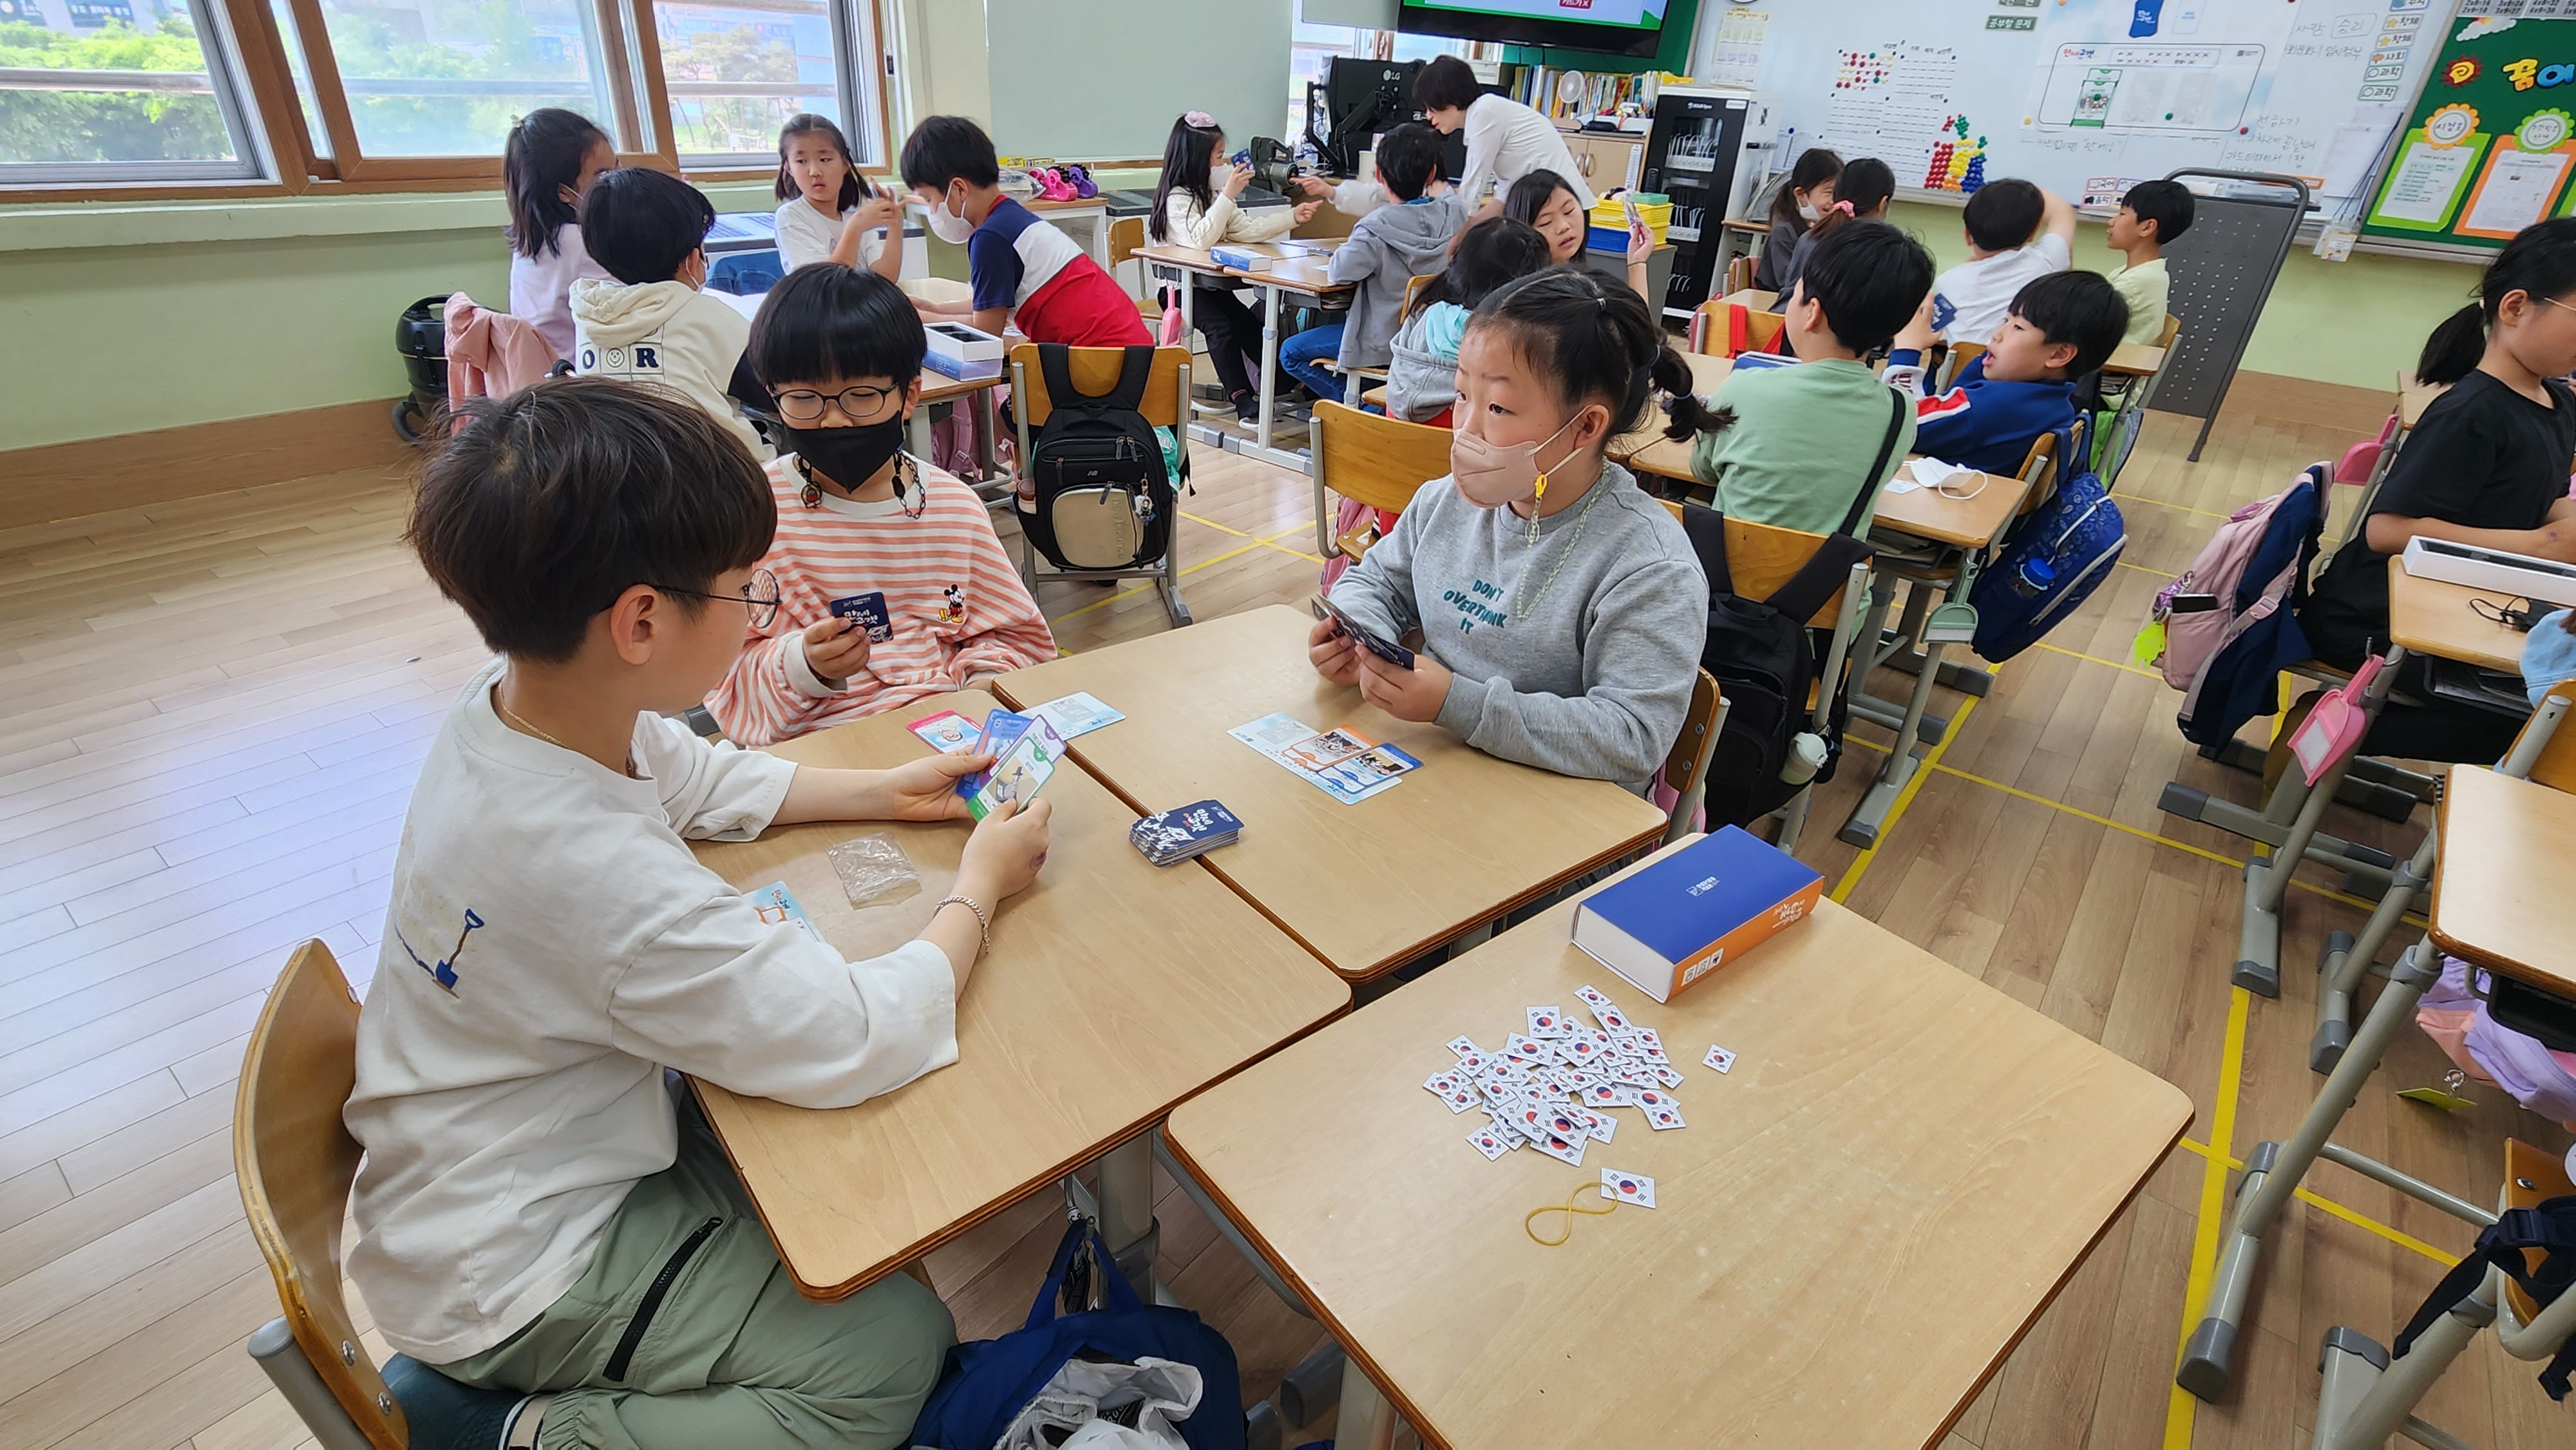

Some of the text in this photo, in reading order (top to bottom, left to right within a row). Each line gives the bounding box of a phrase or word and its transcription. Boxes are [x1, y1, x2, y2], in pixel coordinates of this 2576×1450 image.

[634, 346, 659, 368] R
[1472, 579, 1505, 603] DON'T
[1442, 589, 1508, 629] OVERTHINK
[1459, 617, 1475, 636] IT
